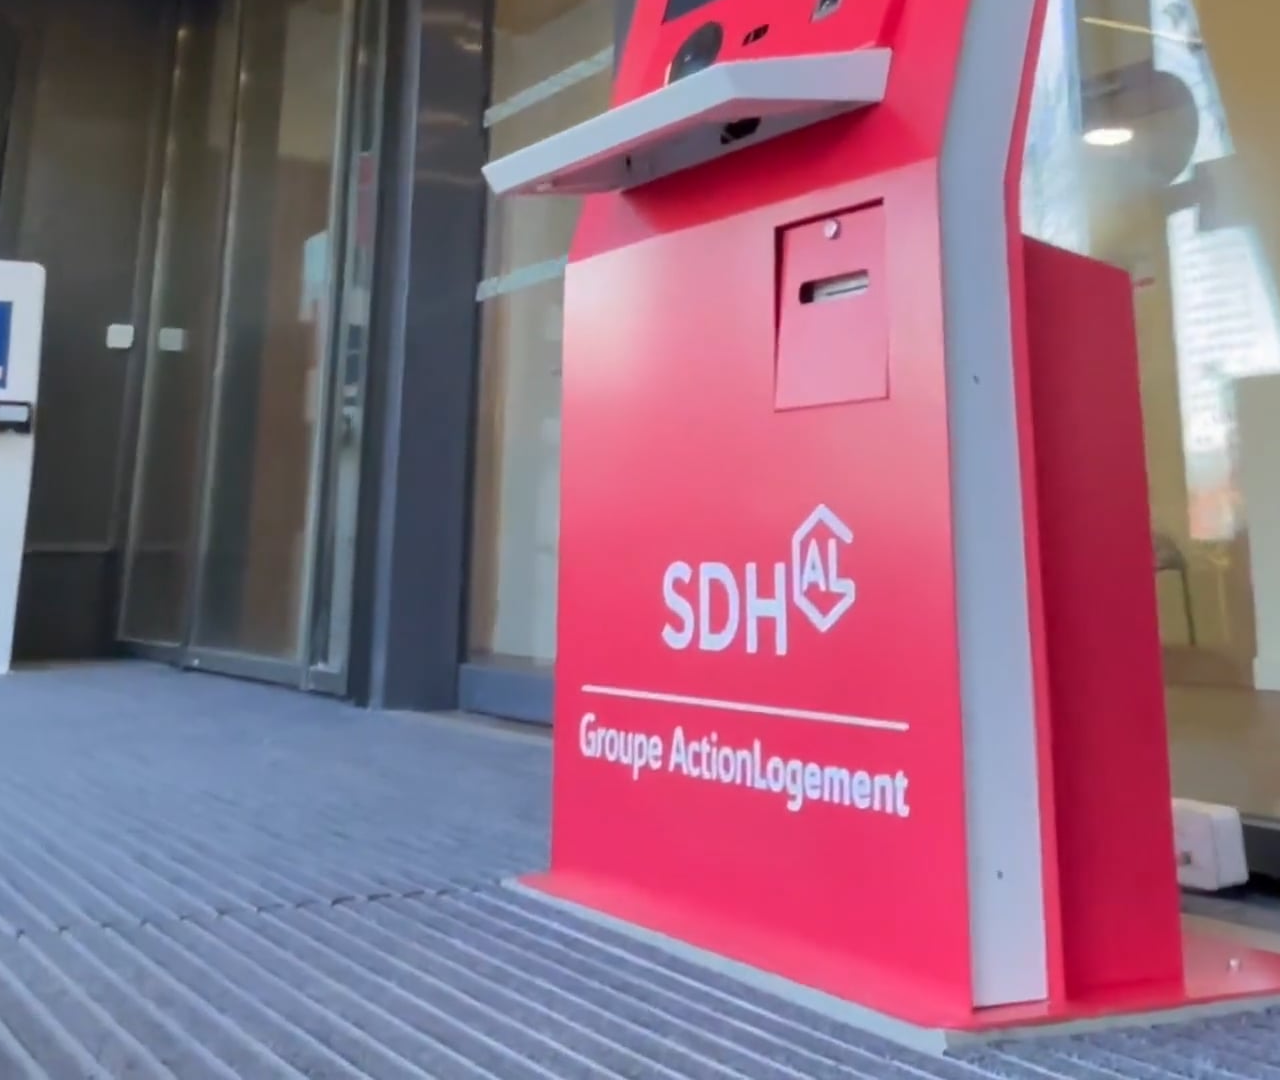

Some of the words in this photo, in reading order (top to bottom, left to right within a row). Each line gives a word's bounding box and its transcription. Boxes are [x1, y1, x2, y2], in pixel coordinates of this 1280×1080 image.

[661, 560, 787, 656] SDH
[579, 713, 663, 781] Groupe
[668, 725, 911, 818] ActionLogement
